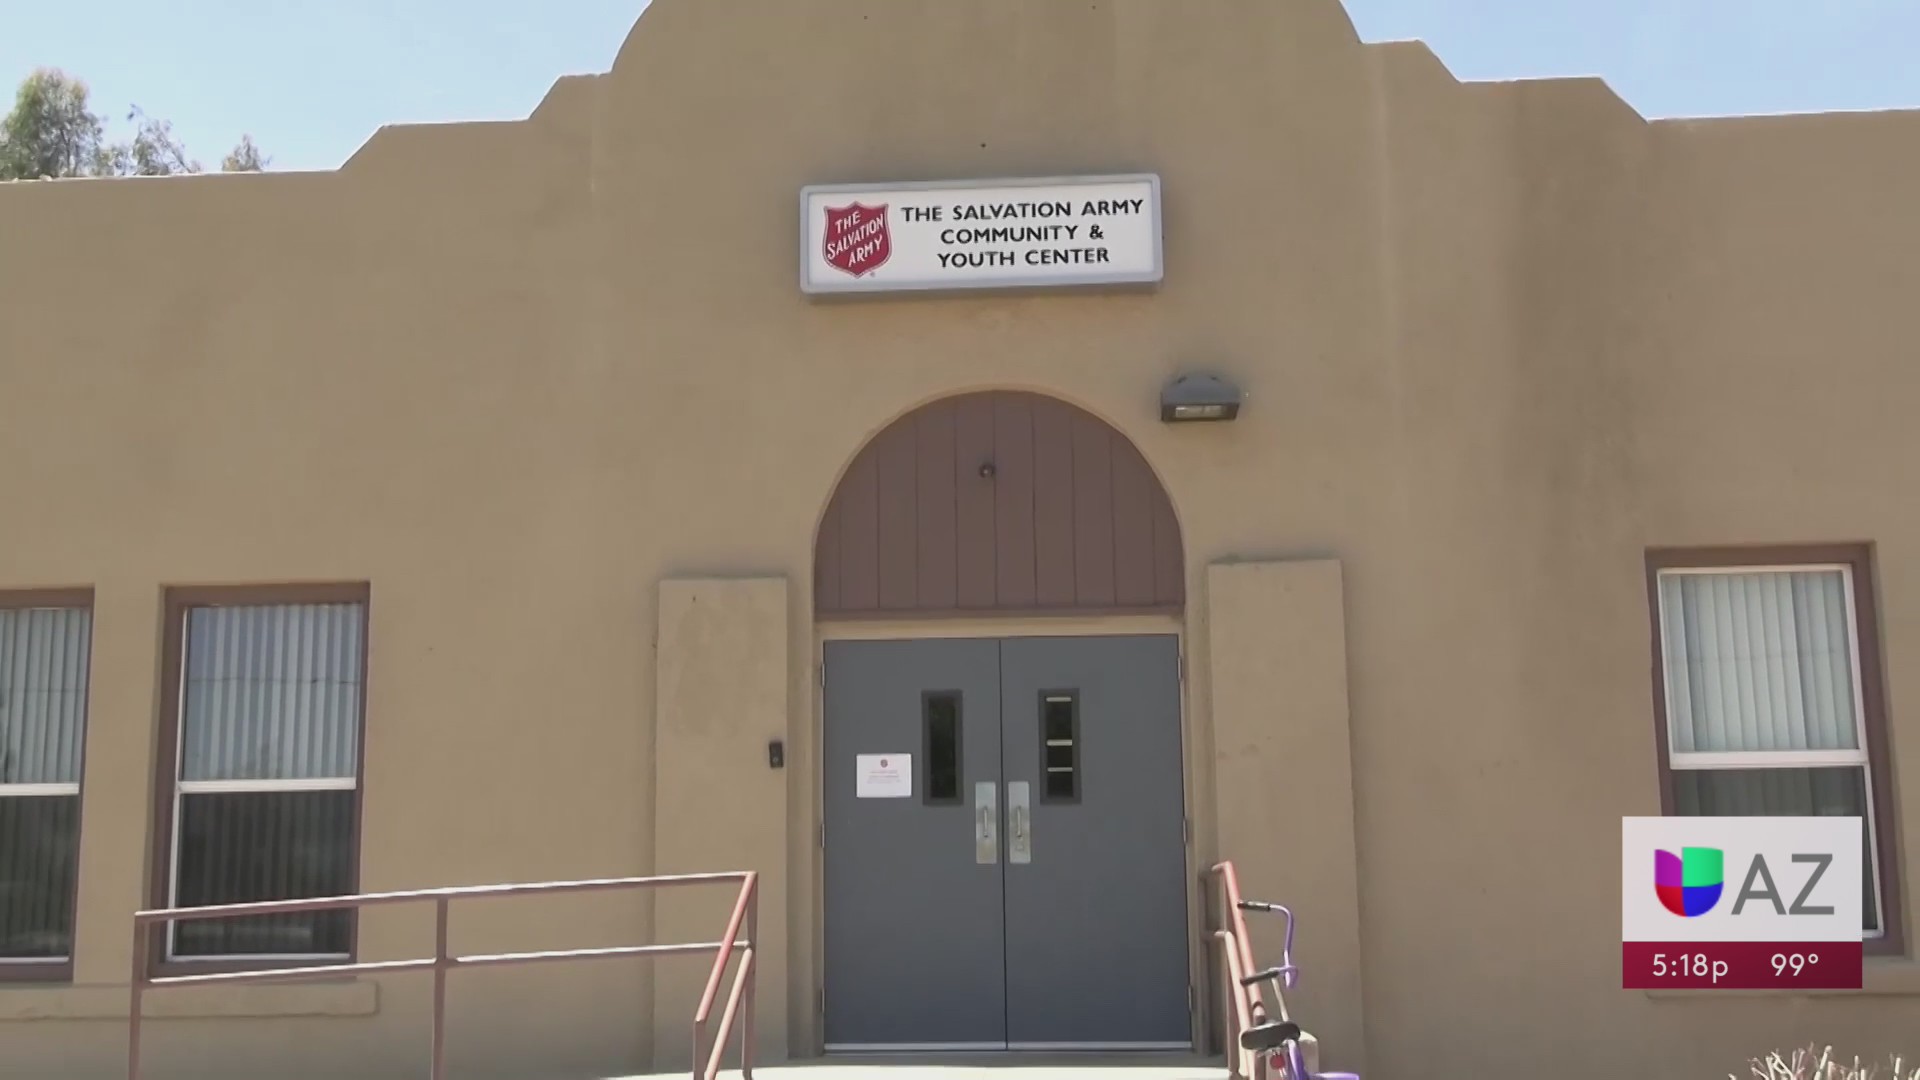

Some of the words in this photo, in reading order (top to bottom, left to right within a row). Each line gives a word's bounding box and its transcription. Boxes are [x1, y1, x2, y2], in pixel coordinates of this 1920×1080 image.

[835, 210, 861, 233] THE
[901, 206, 943, 222] THE
[953, 202, 1071, 220] SALVATION
[1081, 199, 1144, 216] ARMY
[828, 213, 883, 260] SALVATION
[941, 225, 1078, 244] COMMUNITY
[1089, 225, 1104, 240] &
[848, 234, 882, 267] ARMY
[937, 251, 1015, 268] YOUTH
[1025, 247, 1110, 266] CENTER
